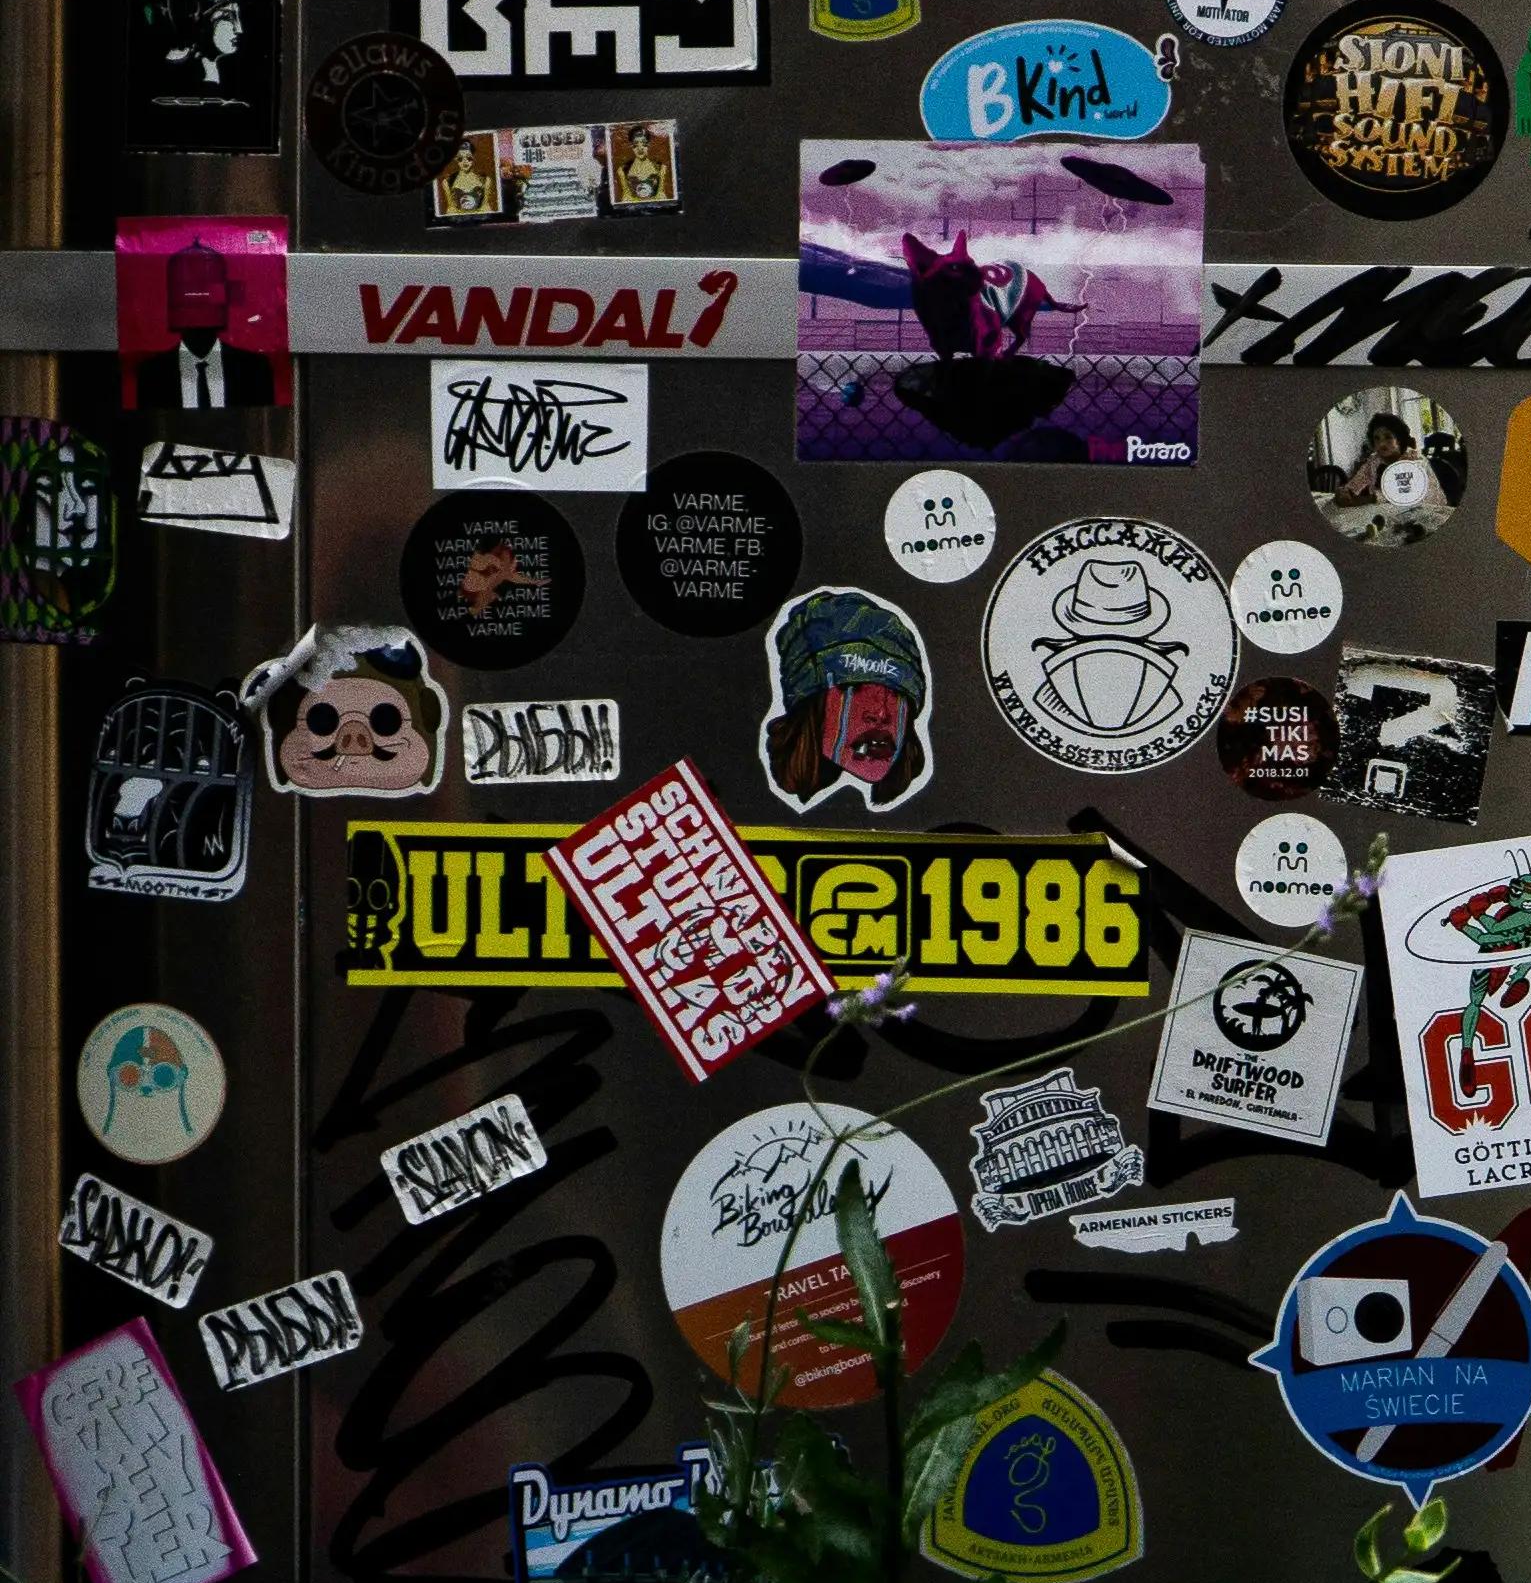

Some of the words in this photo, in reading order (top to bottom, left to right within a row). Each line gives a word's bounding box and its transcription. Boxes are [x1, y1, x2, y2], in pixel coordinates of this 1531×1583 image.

[1197, 4, 1250, 23] MOTIVATOR
[1334, 34, 1468, 82] SIONI
[1334, 70, 1465, 124] HIFI
[1332, 112, 1459, 158] SOUND
[1327, 138, 1452, 182] SYSTEM
[463, 521, 520, 535] VARME
[648, 515, 672, 531] IG:
[676, 517, 774, 534] @VARME-
[734, 540, 765, 556] FB:
[901, 533, 985, 554] noomee
[1026, 523, 1211, 585] ПАССАЖИР
[660, 560, 757, 578] @VARME-
[674, 581, 744, 599] VARME
[497, 604, 551, 619] VARME
[1246, 604, 1332, 625] noomee
[467, 622, 522, 636] VARME
[1243, 705, 1309, 724] #SUSI
[1266, 725, 1309, 743] TIKI
[1261, 744, 1310, 762] MAS
[1248, 766, 1310, 778] 2018.12.01
[650, 780, 817, 1009] SCHWABEN
[1249, 878, 1334, 897] noomee
[919, 857, 1141, 969] 1986
[572, 824, 746, 1061] ULTRAS
[1192, 1049, 1304, 1089] DRIFTWOOD
[1211, 1073, 1278, 1104] SURFER
[711, 1168, 810, 1236] Biking
[1028, 1188, 1064, 1216] OPERA
[1064, 1177, 1099, 1207] HOUSE
[1079, 1213, 1159, 1235] ARMENIAN
[1162, 1204, 1233, 1226] STICKERS
[1340, 1362, 1436, 1395] MARIAN
[1456, 1361, 1489, 1386] NA
[1365, 1391, 1466, 1420] ŚWIECIE
[513, 1470, 685, 1540] Dynamo
